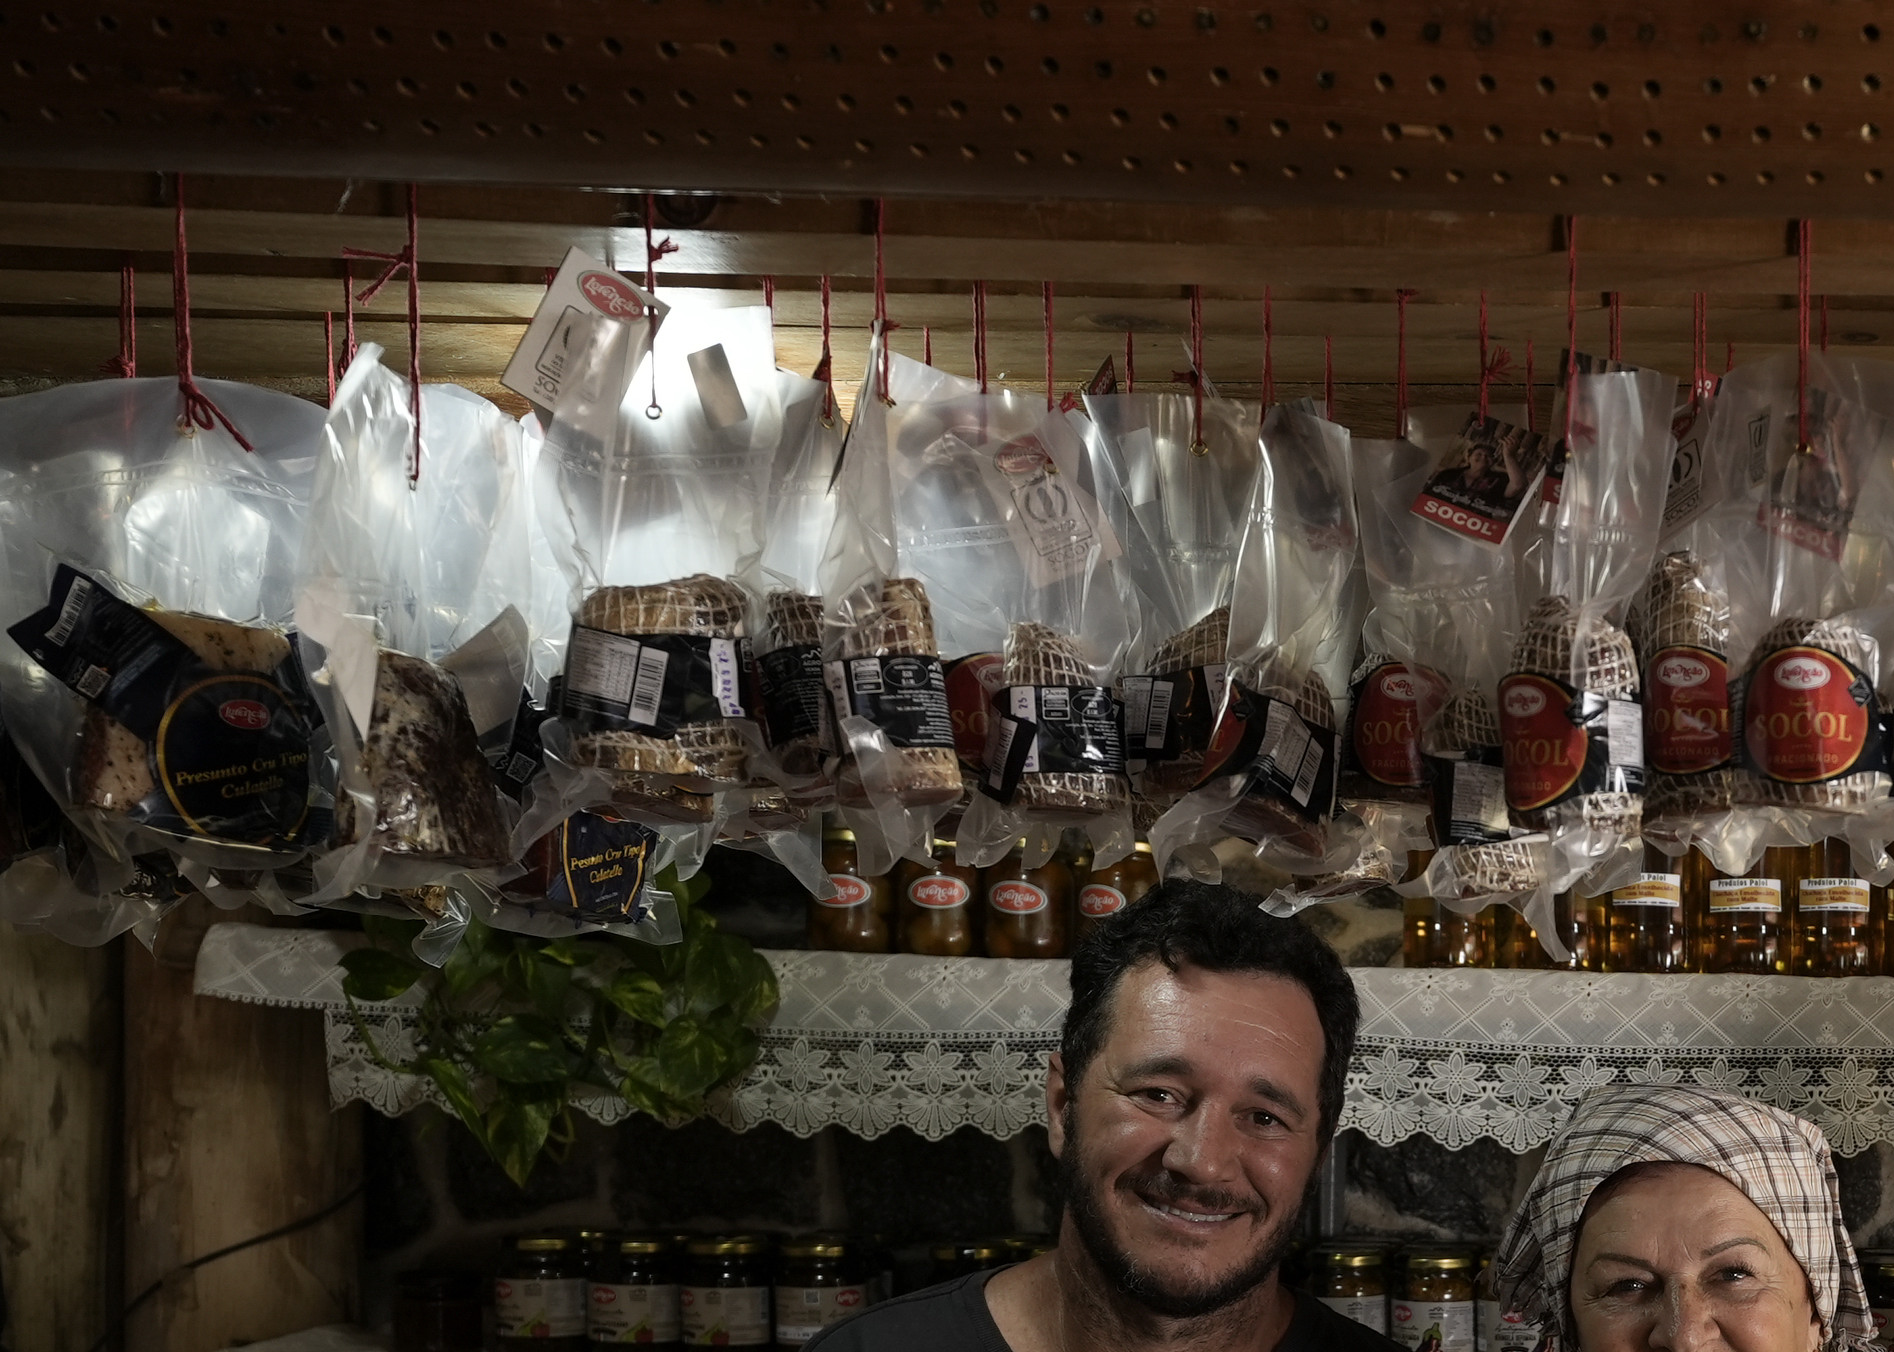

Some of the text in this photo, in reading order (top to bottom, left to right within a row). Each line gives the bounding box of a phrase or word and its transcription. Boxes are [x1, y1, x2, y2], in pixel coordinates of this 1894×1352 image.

[1424, 500, 1493, 536] SOCOL
[1755, 711, 1852, 741] SOCOL
[176, 763, 248, 787] Presunto
[252, 757, 276, 773] Cru
